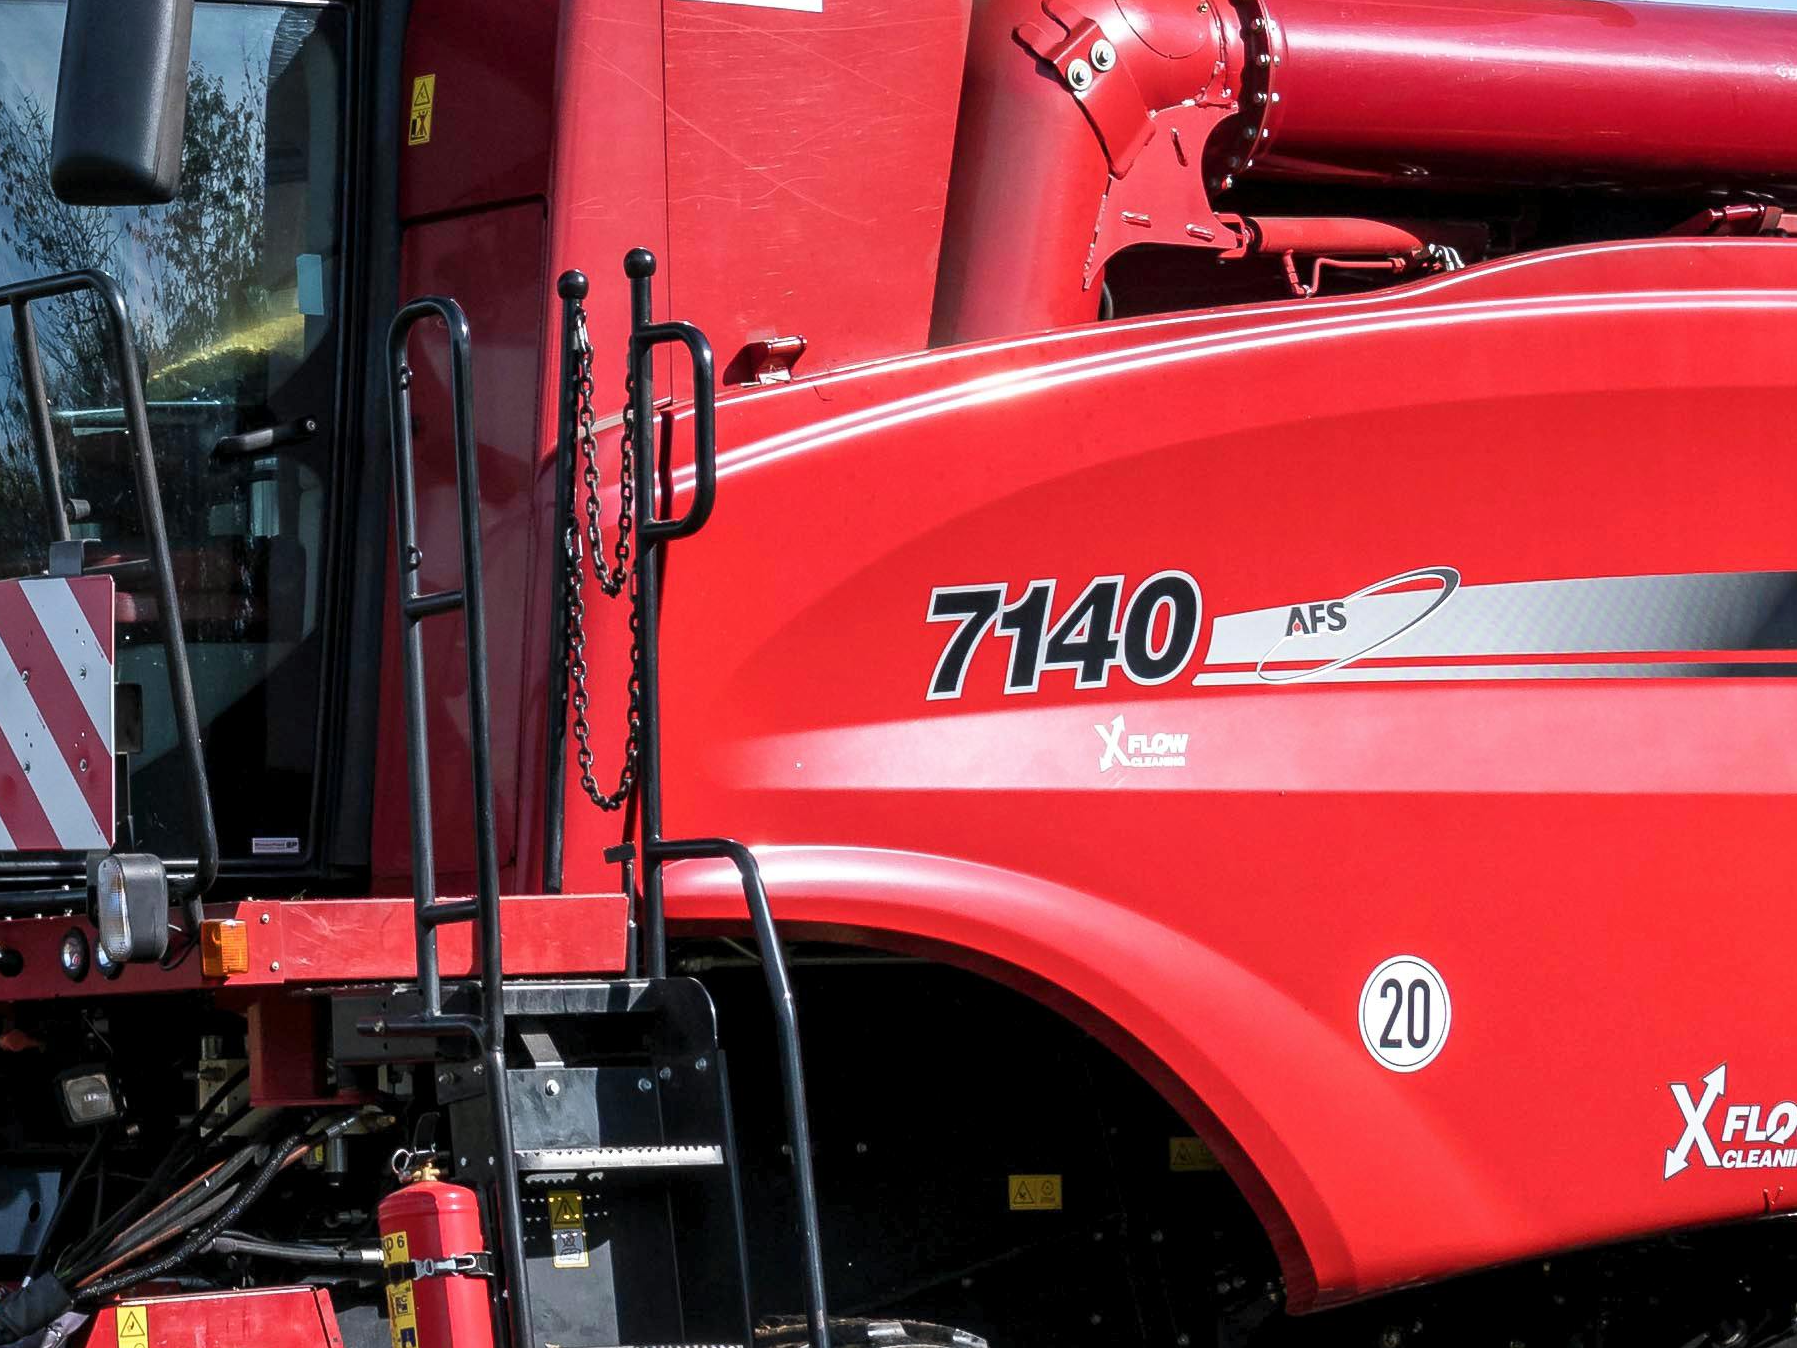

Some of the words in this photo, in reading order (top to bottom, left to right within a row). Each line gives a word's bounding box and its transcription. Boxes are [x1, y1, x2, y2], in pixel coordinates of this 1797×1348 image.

[925, 569, 1203, 701] 7140
[1285, 601, 1347, 637] AFS
[1129, 756, 1186, 767] CLEANING
[1379, 978, 1431, 1049] 20
